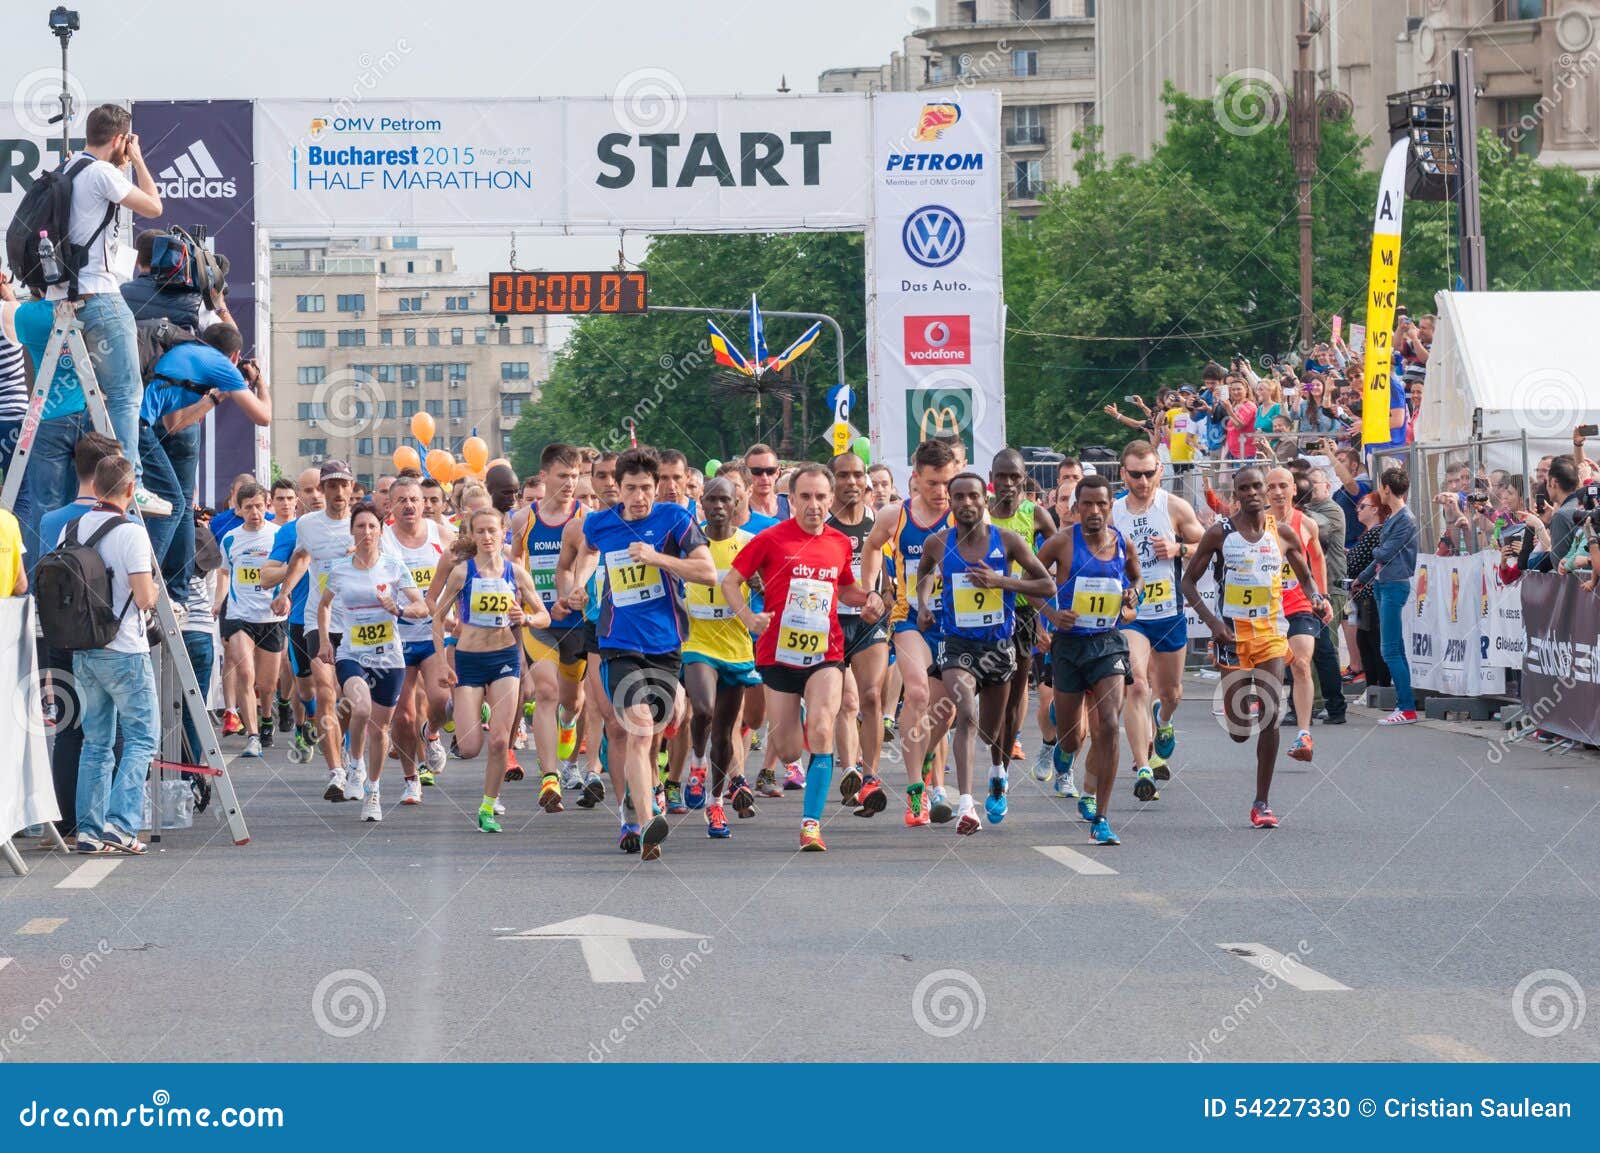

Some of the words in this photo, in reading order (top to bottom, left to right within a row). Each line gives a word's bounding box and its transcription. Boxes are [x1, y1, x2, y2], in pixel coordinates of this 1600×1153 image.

[334, 117, 375, 131] OMV
[381, 117, 442, 131] Petrom
[308, 146, 419, 166] Bucharest
[423, 147, 475, 166] 2015
[595, 131, 832, 189] START
[886, 153, 983, 171] PETROM
[308, 170, 375, 190] HALF
[383, 169, 532, 190] MARATHON
[919, 178, 929, 186] of
[930, 178, 949, 186] OMV
[950, 178, 976, 187] Group
[901, 280, 928, 292] Das
[932, 279, 972, 292] Auto.
[910, 348, 965, 360] vodafone
[1133, 517, 1148, 527] LEE
[411, 570, 432, 583] 84
[619, 563, 648, 585] 117
[792, 564, 816, 579] city
[818, 566, 839, 580] grill
[479, 595, 508, 612] 525
[707, 587, 715, 604] 1
[974, 592, 985, 611] 9
[1242, 589, 1253, 606] 5
[1089, 596, 1105, 613] 11
[357, 624, 387, 641] 482
[787, 631, 819, 651] 599
